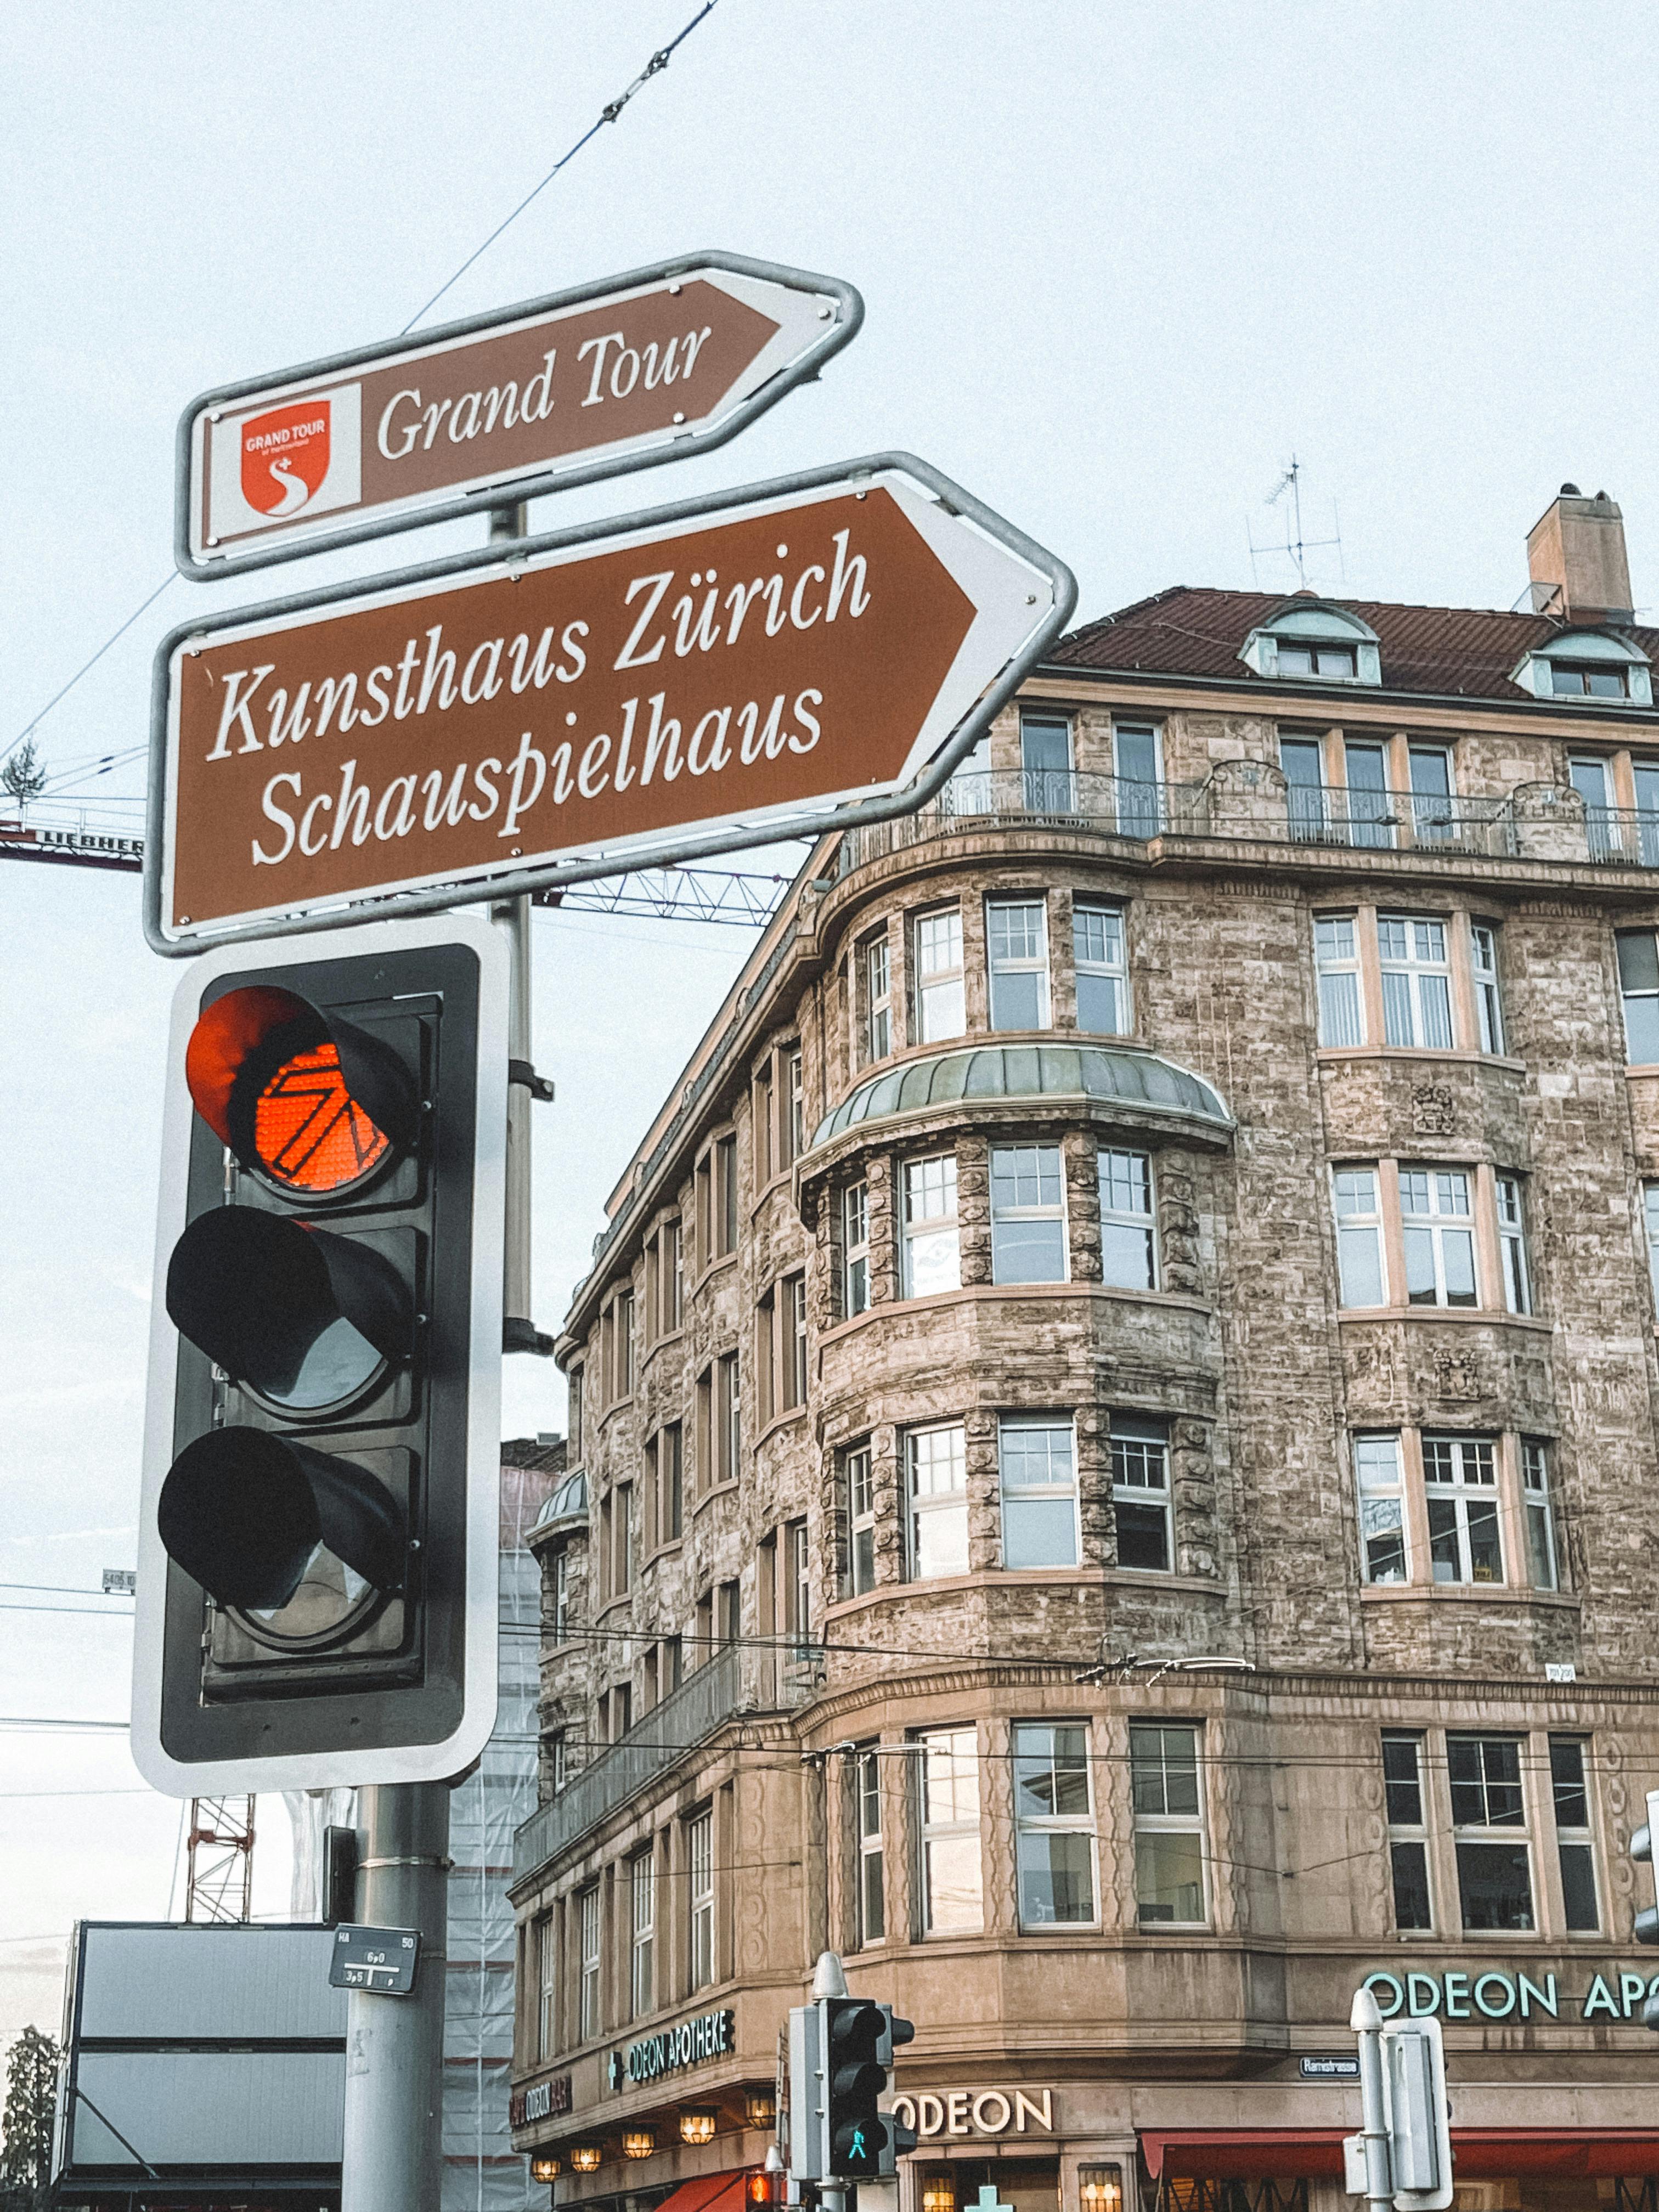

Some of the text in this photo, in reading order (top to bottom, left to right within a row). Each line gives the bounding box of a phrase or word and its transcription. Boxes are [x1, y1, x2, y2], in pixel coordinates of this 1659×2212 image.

[377, 326, 712, 460] Grand Tour
[246, 428, 290, 452] GRAND
[292, 419, 325, 439] TOUR
[206, 528, 871, 761] Kunsthaus Zürich
[252, 689, 823, 866] Schauspielhaus
[367, 1952, 385, 1964] 6,0
[402, 1937, 414, 1948] 50
[346, 1971, 363, 1983] 3,5
[1363, 1973, 1659, 2018] ODEON AP
[628, 2010, 726, 2081] ODEON APOTHEKE
[891, 2089, 1053, 2135] ODEON
